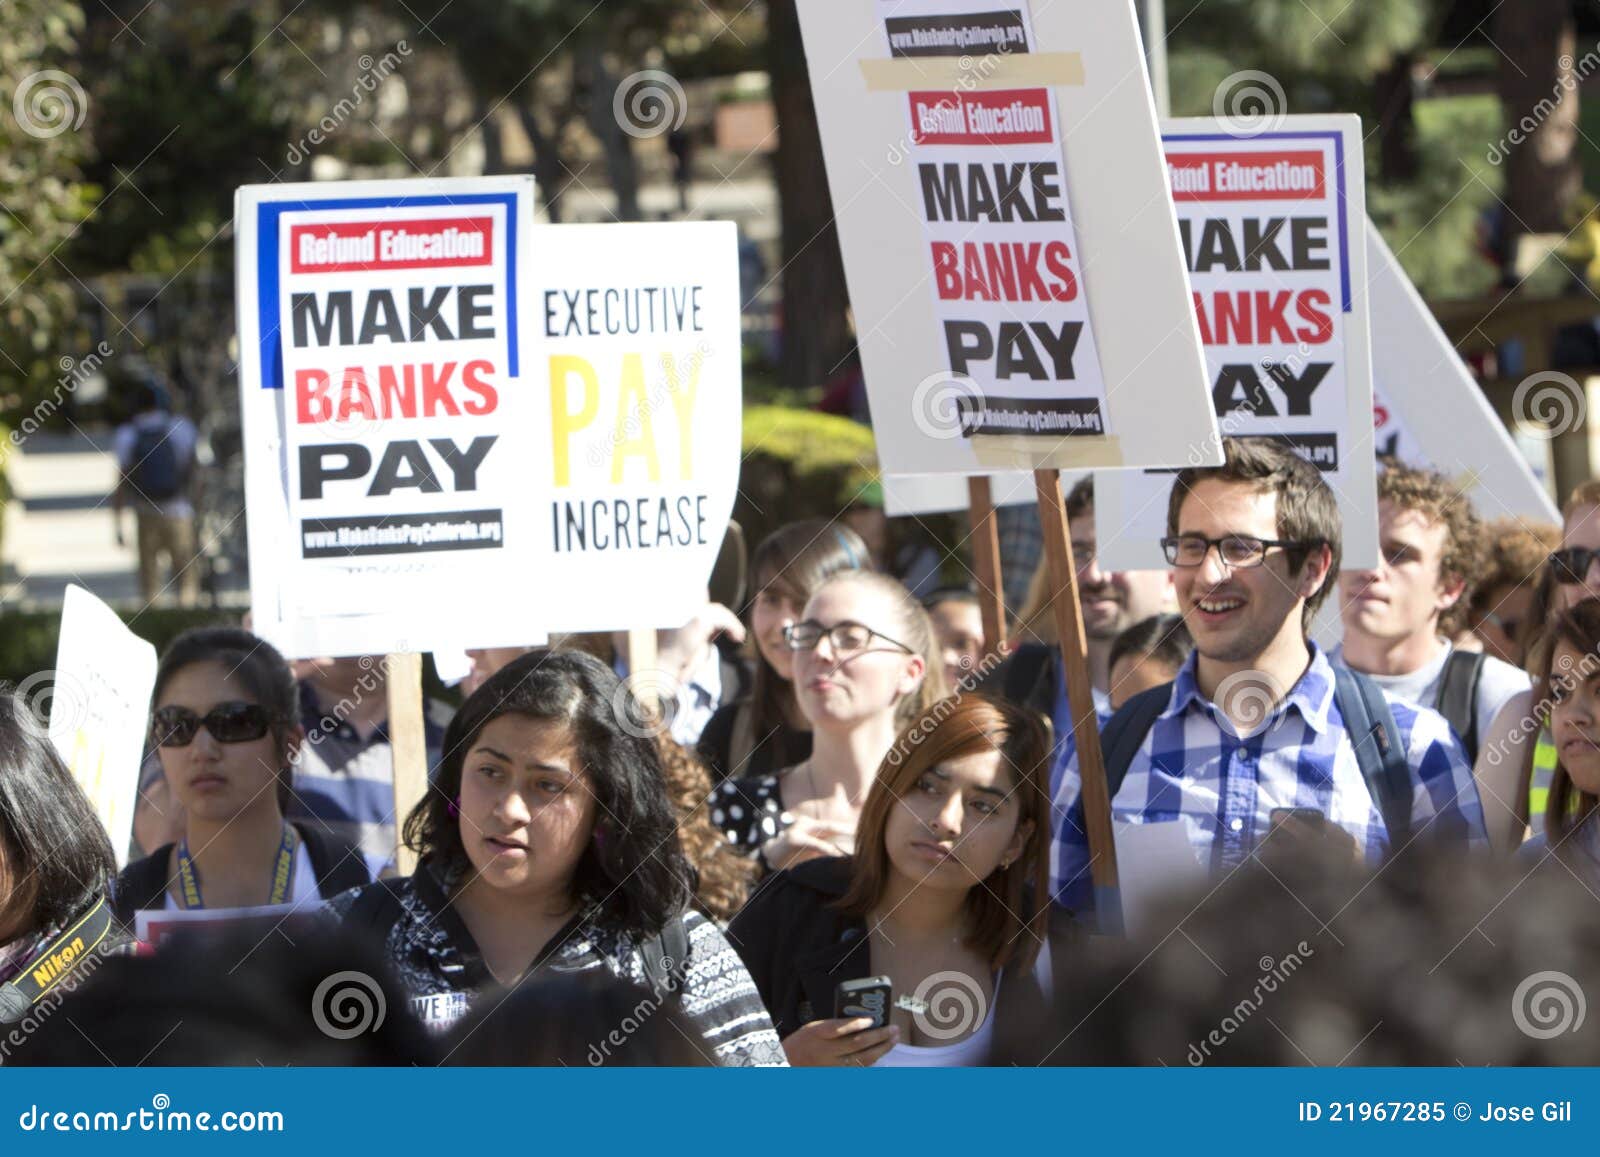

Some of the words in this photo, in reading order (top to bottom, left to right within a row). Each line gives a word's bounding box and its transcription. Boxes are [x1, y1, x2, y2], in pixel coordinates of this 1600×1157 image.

[967, 101, 1045, 134] Education
[918, 162, 1066, 223] MAKE
[1214, 161, 1315, 193] Education
[299, 233, 374, 265] Refund
[380, 229, 484, 261] Education
[930, 241, 1078, 302] BANKS
[290, 284, 496, 348] MAKE
[544, 285, 703, 338] EXECUTIVE
[1192, 288, 1334, 347] ANKS
[943, 319, 1084, 382] PAY
[294, 359, 499, 424] BANKS
[1211, 361, 1335, 416] AY
[549, 351, 702, 488] PAY
[299, 435, 499, 501] PAY
[552, 495, 708, 553] INCREASE
[32, 937, 85, 988] Nikon
